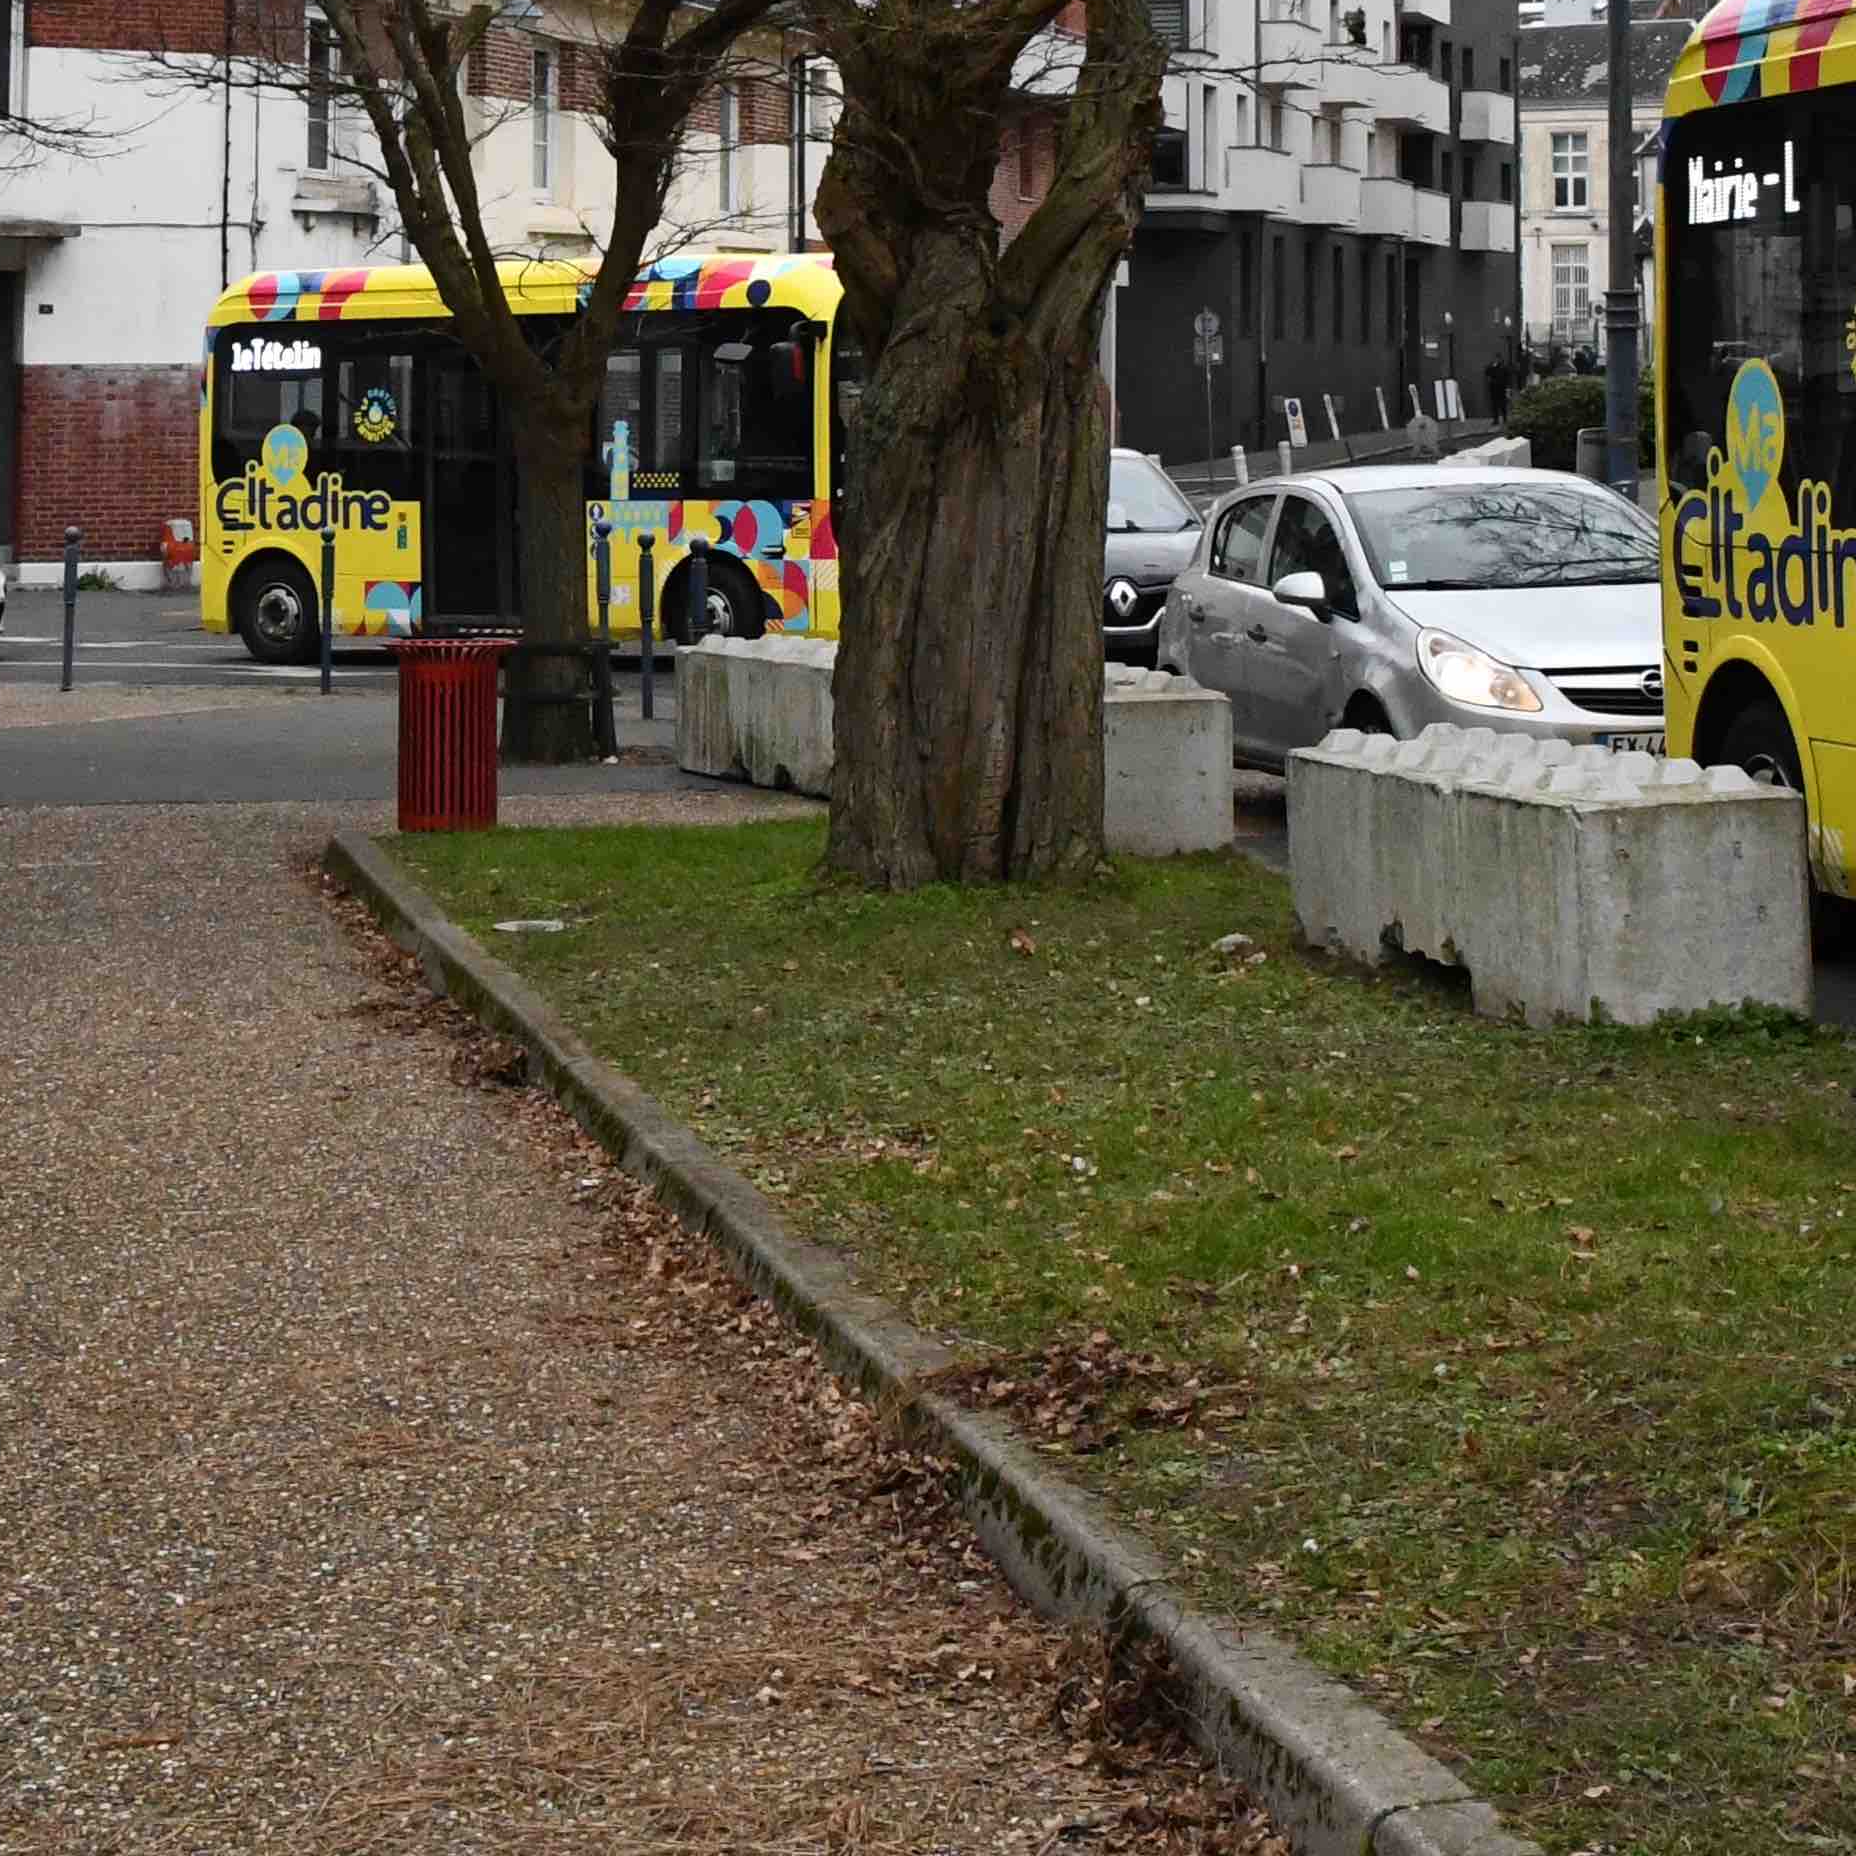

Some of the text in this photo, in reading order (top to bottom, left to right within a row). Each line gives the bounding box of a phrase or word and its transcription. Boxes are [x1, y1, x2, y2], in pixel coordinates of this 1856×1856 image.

[1688, 155, 1758, 225] Mairie
[1784, 140, 1800, 213] L
[216, 462, 391, 531] Citadine
